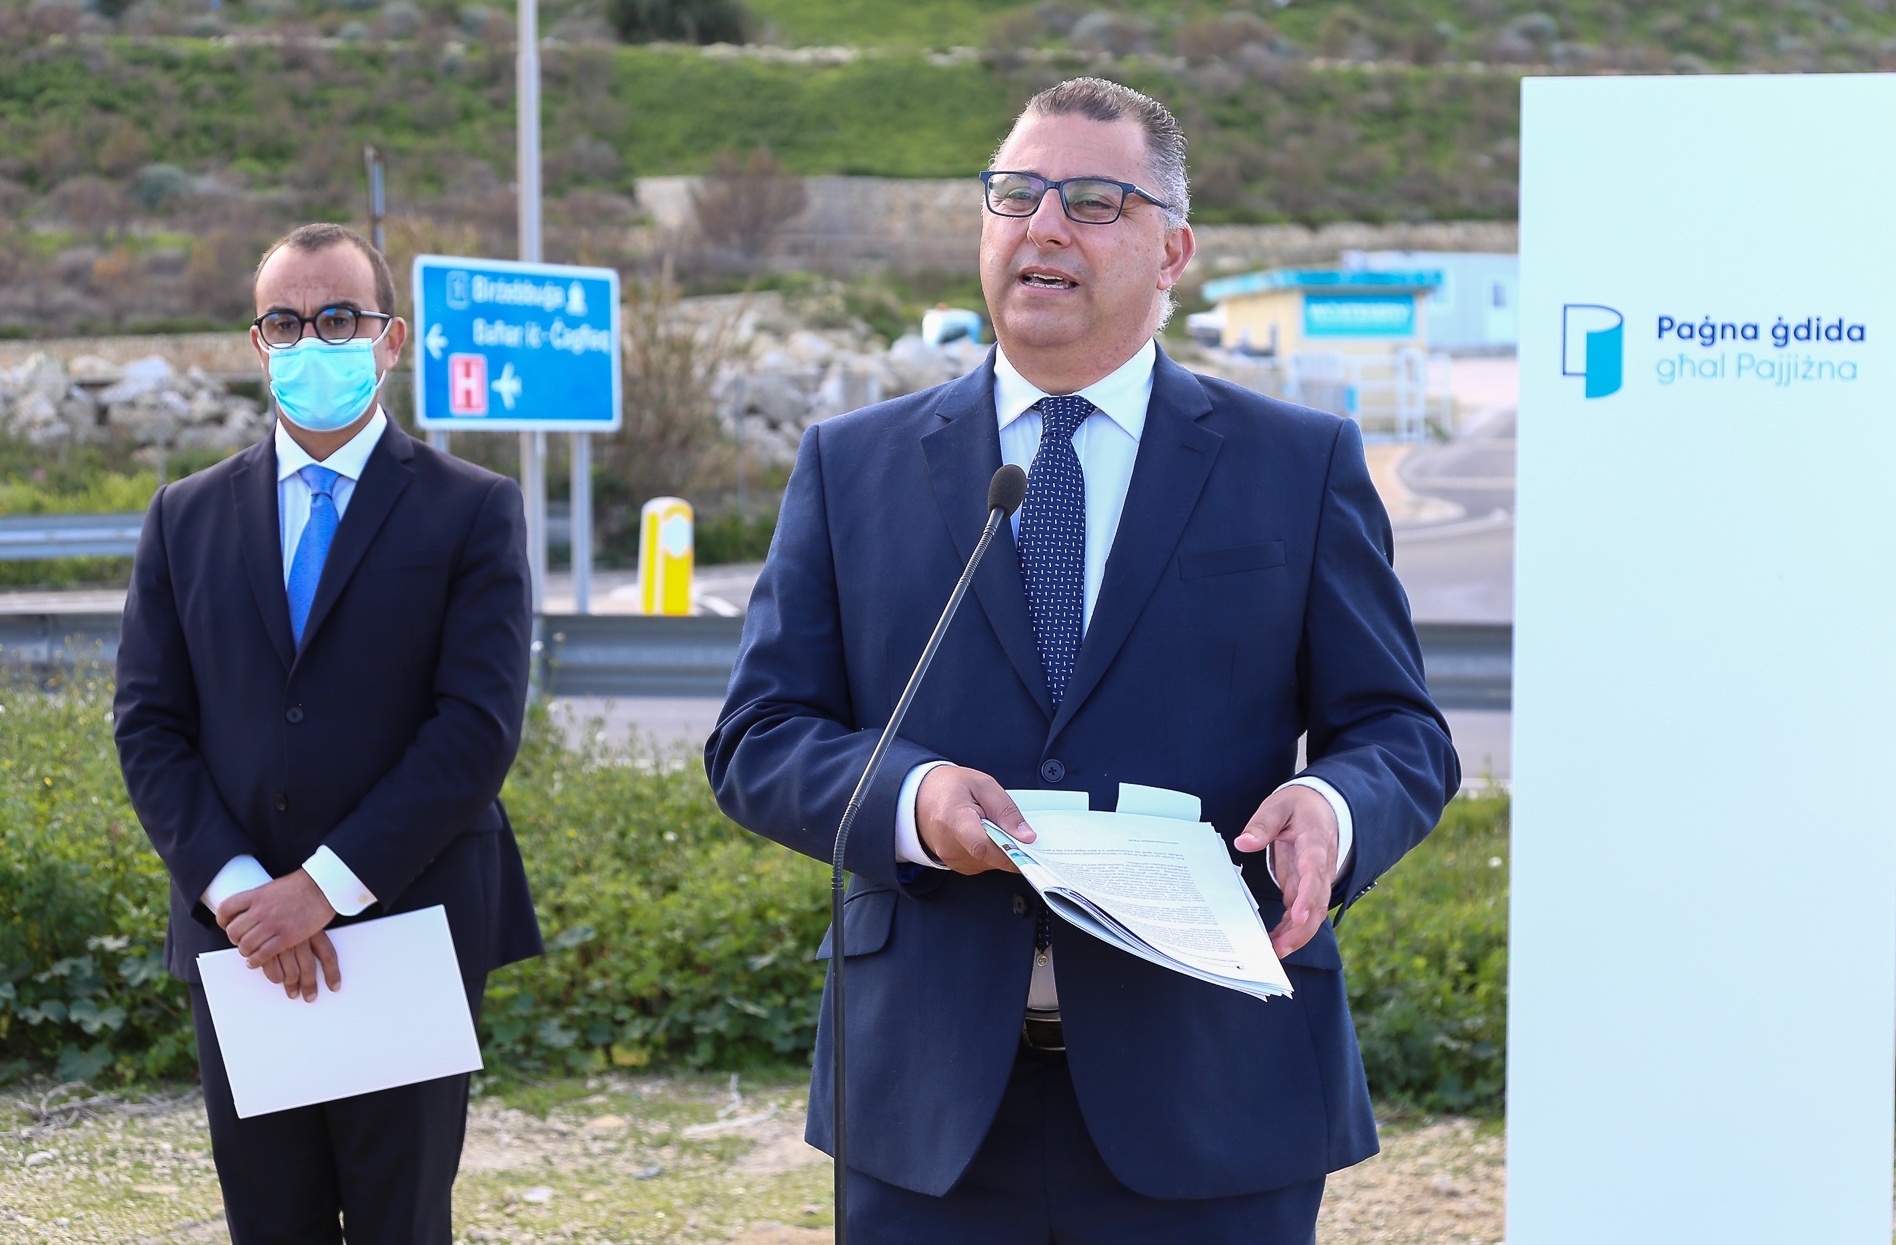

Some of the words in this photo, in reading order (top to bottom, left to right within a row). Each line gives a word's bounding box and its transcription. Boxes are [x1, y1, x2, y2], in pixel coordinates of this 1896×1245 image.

[1658, 315, 1759, 347] Paġna
[1771, 316, 1866, 348] ġdida
[453, 361, 484, 410] H
[1656, 353, 1725, 384] għal
[1737, 353, 1857, 386] Pajjiżna
